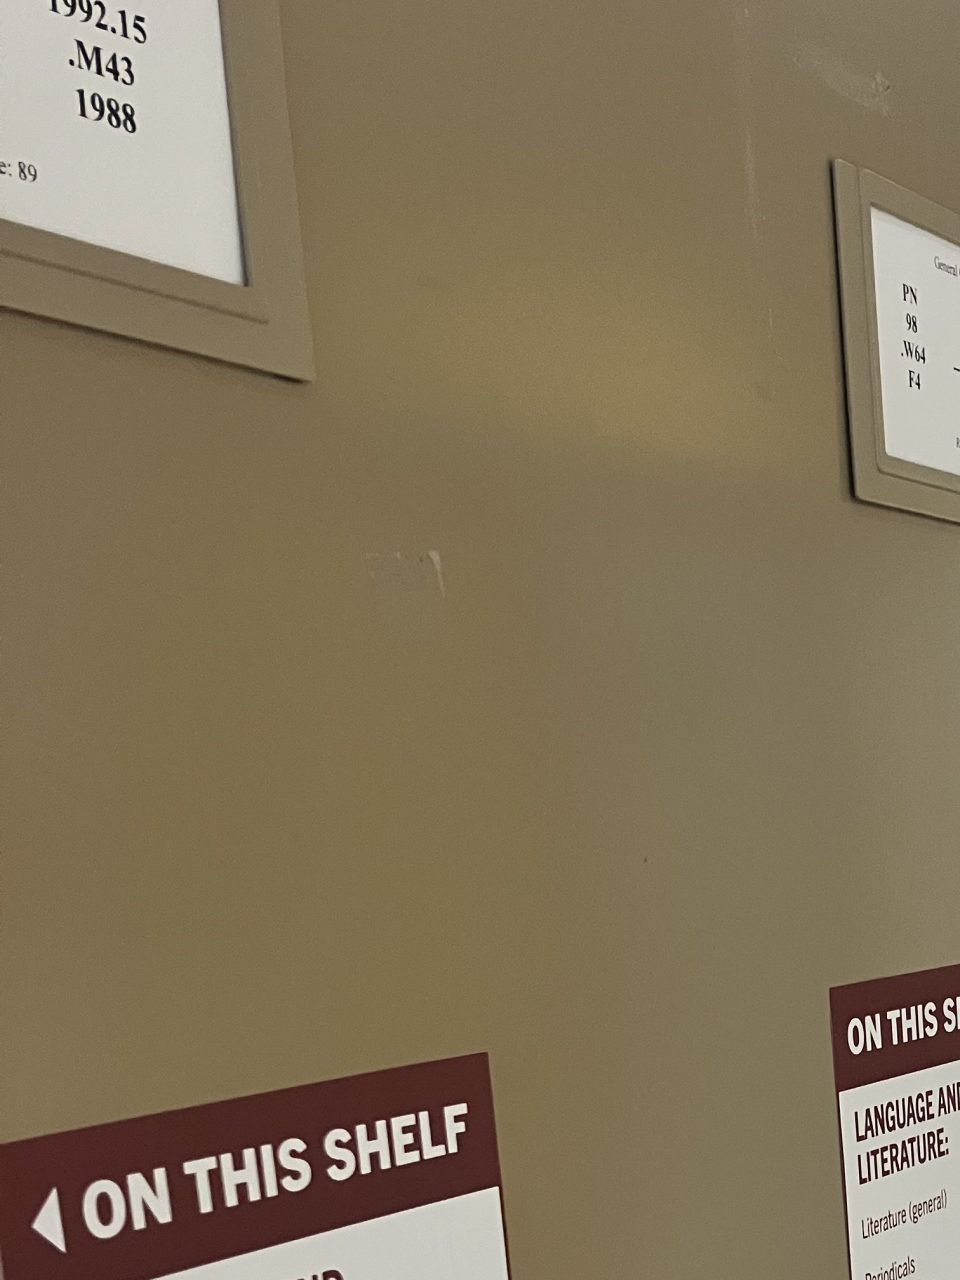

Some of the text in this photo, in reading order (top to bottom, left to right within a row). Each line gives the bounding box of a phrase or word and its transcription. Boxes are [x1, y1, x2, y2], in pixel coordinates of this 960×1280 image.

[69, 39, 135, 86] .M43
[76, 88, 137, 134] 1988
[18, 160, 38, 183] 89
[933, 256, 958, 278] General
[902, 283, 918, 305] PN
[905, 313, 918, 334] 98
[900, 340, 926, 364] .W64
[908, 369, 921, 390] F4
[847, 1013, 882, 1055] ON
[886, 1001, 938, 1046] THIS
[854, 1090, 935, 1143] LANGUAGE
[82, 1102, 468, 1239] ON THIS SHELF
[857, 1127, 949, 1186] LITERATURE:
[861, 1188, 948, 1239] Literature (general)
